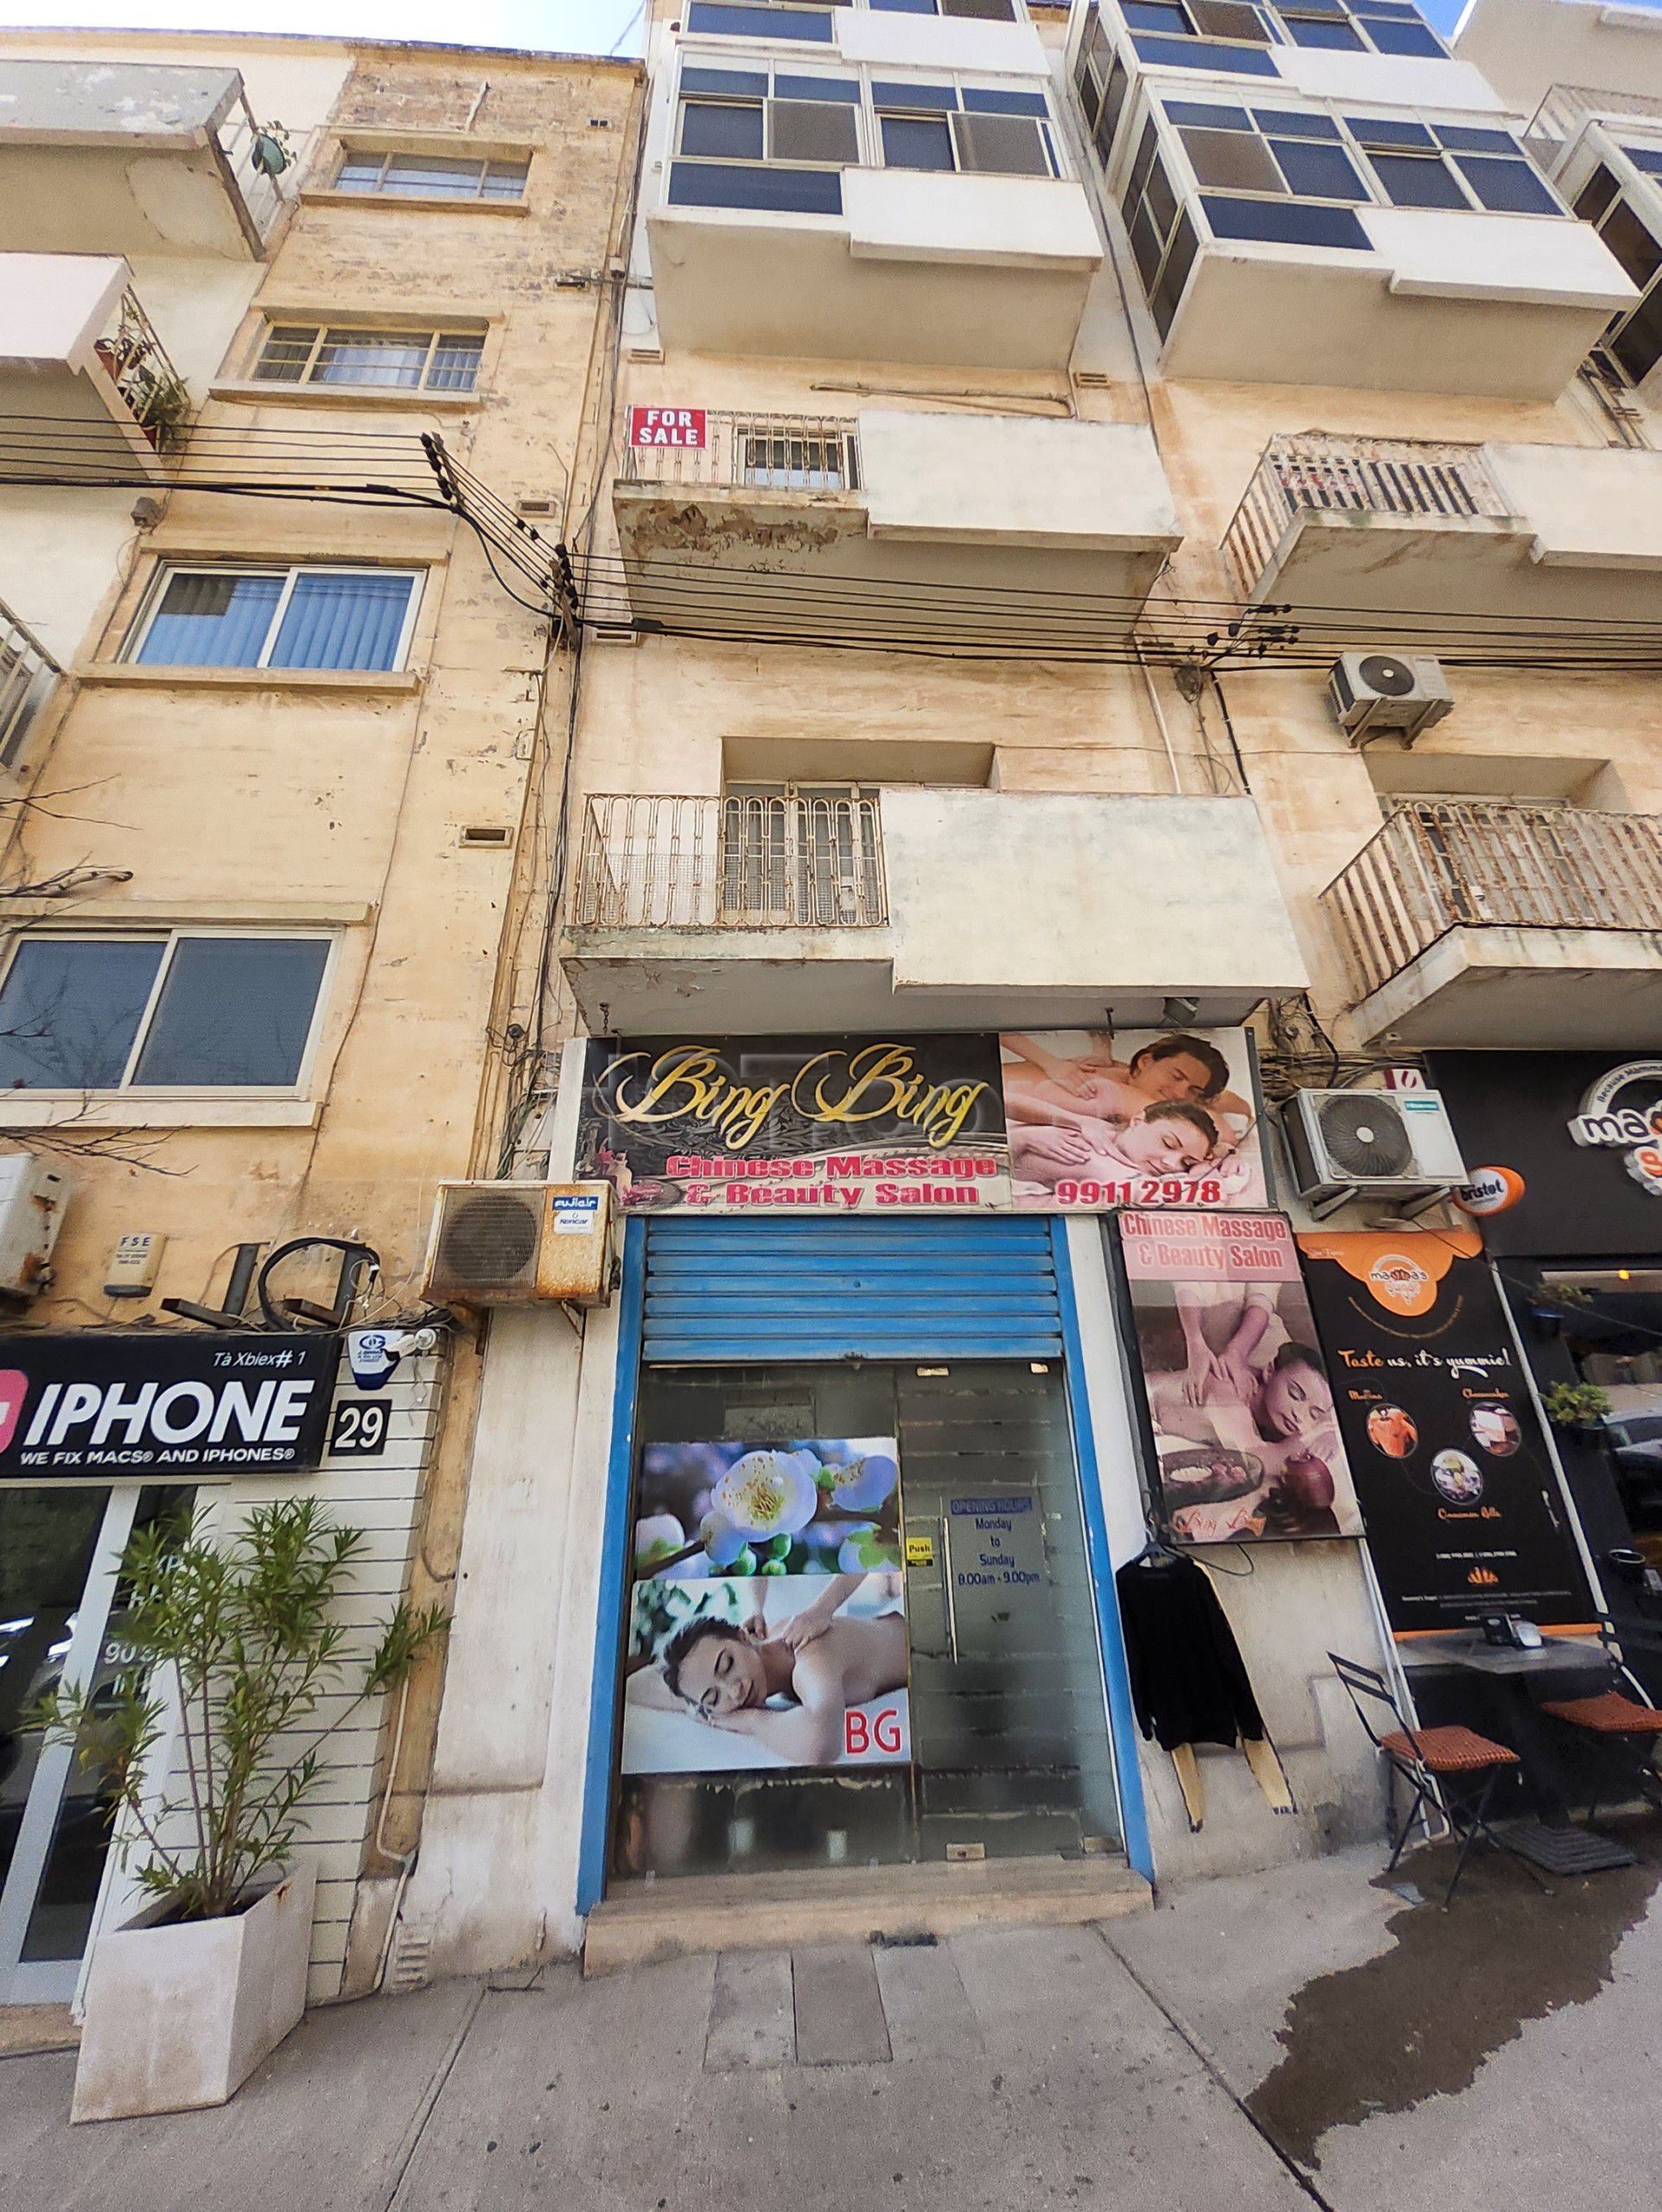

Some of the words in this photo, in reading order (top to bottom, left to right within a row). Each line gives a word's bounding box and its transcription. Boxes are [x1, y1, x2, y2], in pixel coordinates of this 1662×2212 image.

[646, 410, 692, 427] FOR
[640, 427, 698, 445] SALE
[592, 1045, 791, 1150] Bing
[791, 1043, 990, 1148] Bing
[665, 1154, 816, 1179] Chinese
[825, 1154, 998, 1180] Massage
[686, 1182, 713, 1206] &
[726, 1181, 864, 1209] Beauty
[875, 1182, 980, 1205] Salon
[1056, 1179, 1132, 1205] 9911
[1140, 1179, 1221, 1205] 2978
[1124, 1212, 1198, 1236] Chinese
[1200, 1215, 1287, 1242] Massage
[1138, 1242, 1152, 1266] &
[1156, 1243, 1226, 1269] Beauty
[1229, 1244, 1283, 1268] Salon
[1338, 1349, 1383, 1369] Taste
[22, 1380, 315, 1446] IPHONE
[334, 1407, 384, 1448] 29
[21, 1451, 50, 1465] WE
[52, 1450, 84, 1465] FIX
[156, 1448, 200, 1464] AND
[952, 1499, 995, 1514] OPENING
[975, 1517, 1012, 1531] Monday
[908, 1543, 931, 1553] Push
[990, 1535, 1001, 1548] to
[979, 1554, 1015, 1567] Sunday
[845, 1709, 901, 1753] BG
